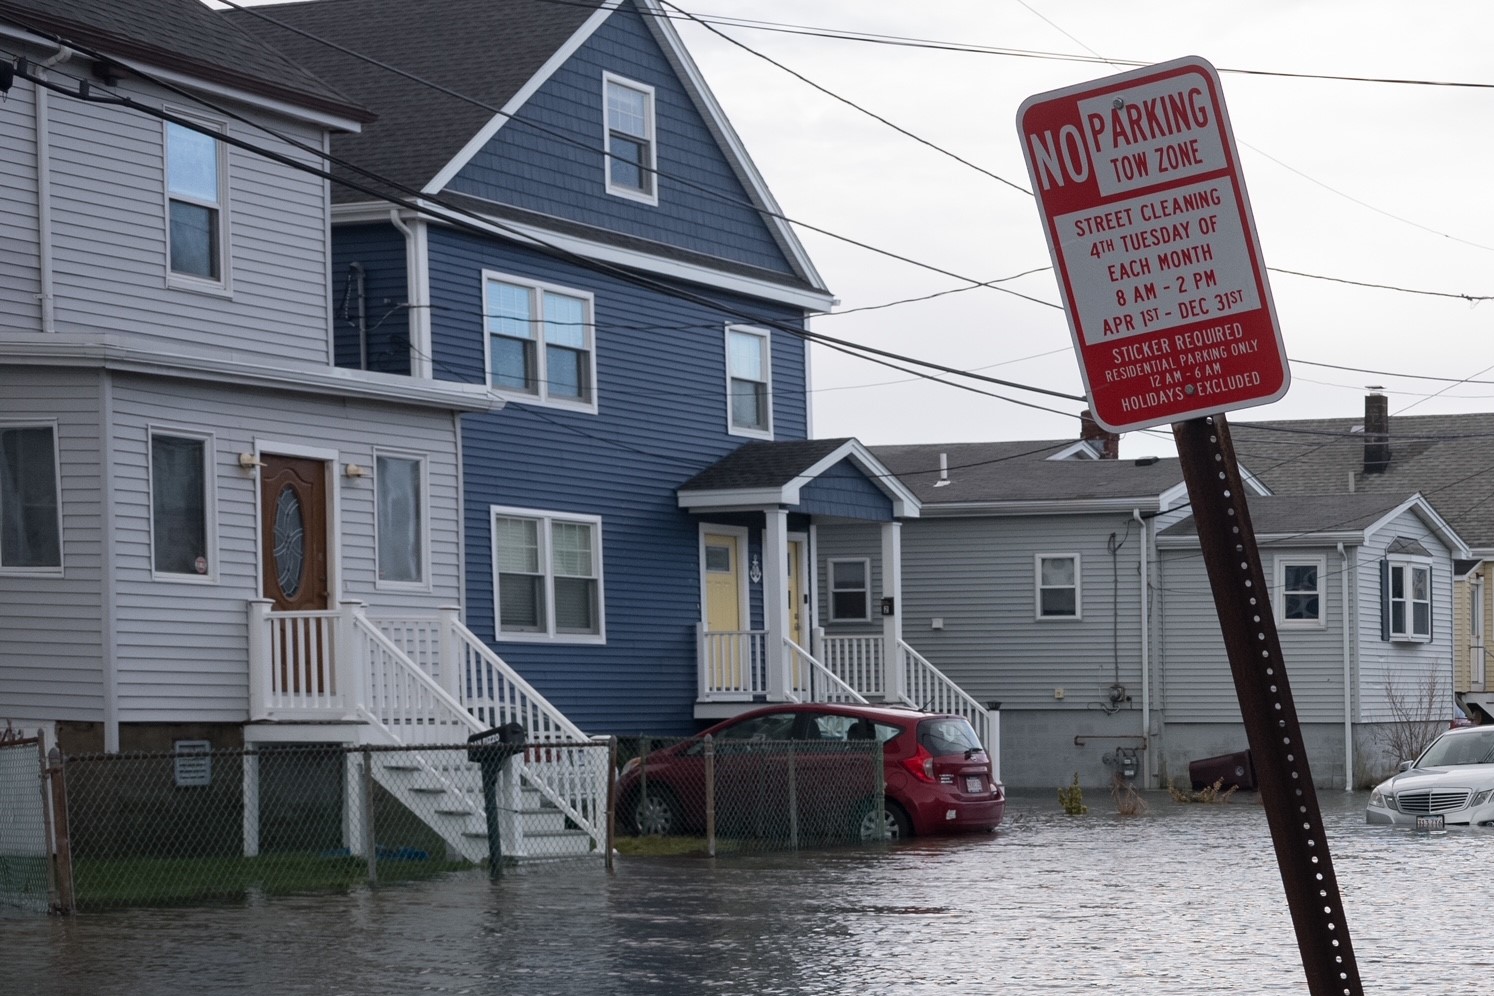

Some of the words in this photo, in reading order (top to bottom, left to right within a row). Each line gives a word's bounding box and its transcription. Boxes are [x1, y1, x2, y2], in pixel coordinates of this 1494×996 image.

[1030, 124, 1089, 190] NO
[1087, 87, 1208, 152] PARKING
[1110, 152, 1148, 183] TOW
[1154, 139, 1203, 173] ZONE
[1075, 209, 1133, 237] STREET
[1140, 188, 1221, 222] CLEANING
[1090, 240, 1115, 259] 4TH
[1120, 221, 1191, 253] TUESDAY
[1199, 215, 1217, 236] OF
[1108, 257, 1150, 282] EACH
[1158, 243, 1214, 271] MONTH
[1116, 290, 1127, 306] 8
[1134, 283, 1157, 304] AM
[1177, 276, 1188, 294] 2
[1193, 269, 1217, 290] PM
[1103, 313, 1135, 336] APR
[1140, 307, 1160, 327] 1ST
[1178, 297, 1210, 320] DEC
[1216, 289, 1244, 312] 31ST
[1105, 354, 1177, 383] RESIDENTIAL
[1179, 345, 1228, 366] PARKING
[1231, 339, 1259, 357] ONLY
[1112, 338, 1171, 364] STICKER
[1175, 322, 1243, 352] REQUIRED
[1121, 386, 1184, 412] HOLIDAYS
[1197, 371, 1261, 396] EXCLUDED
[1150, 375, 1162, 388] 12
[1165, 370, 1182, 385] AM
[1195, 368, 1202, 379] 6
[1205, 362, 1222, 377] AM
